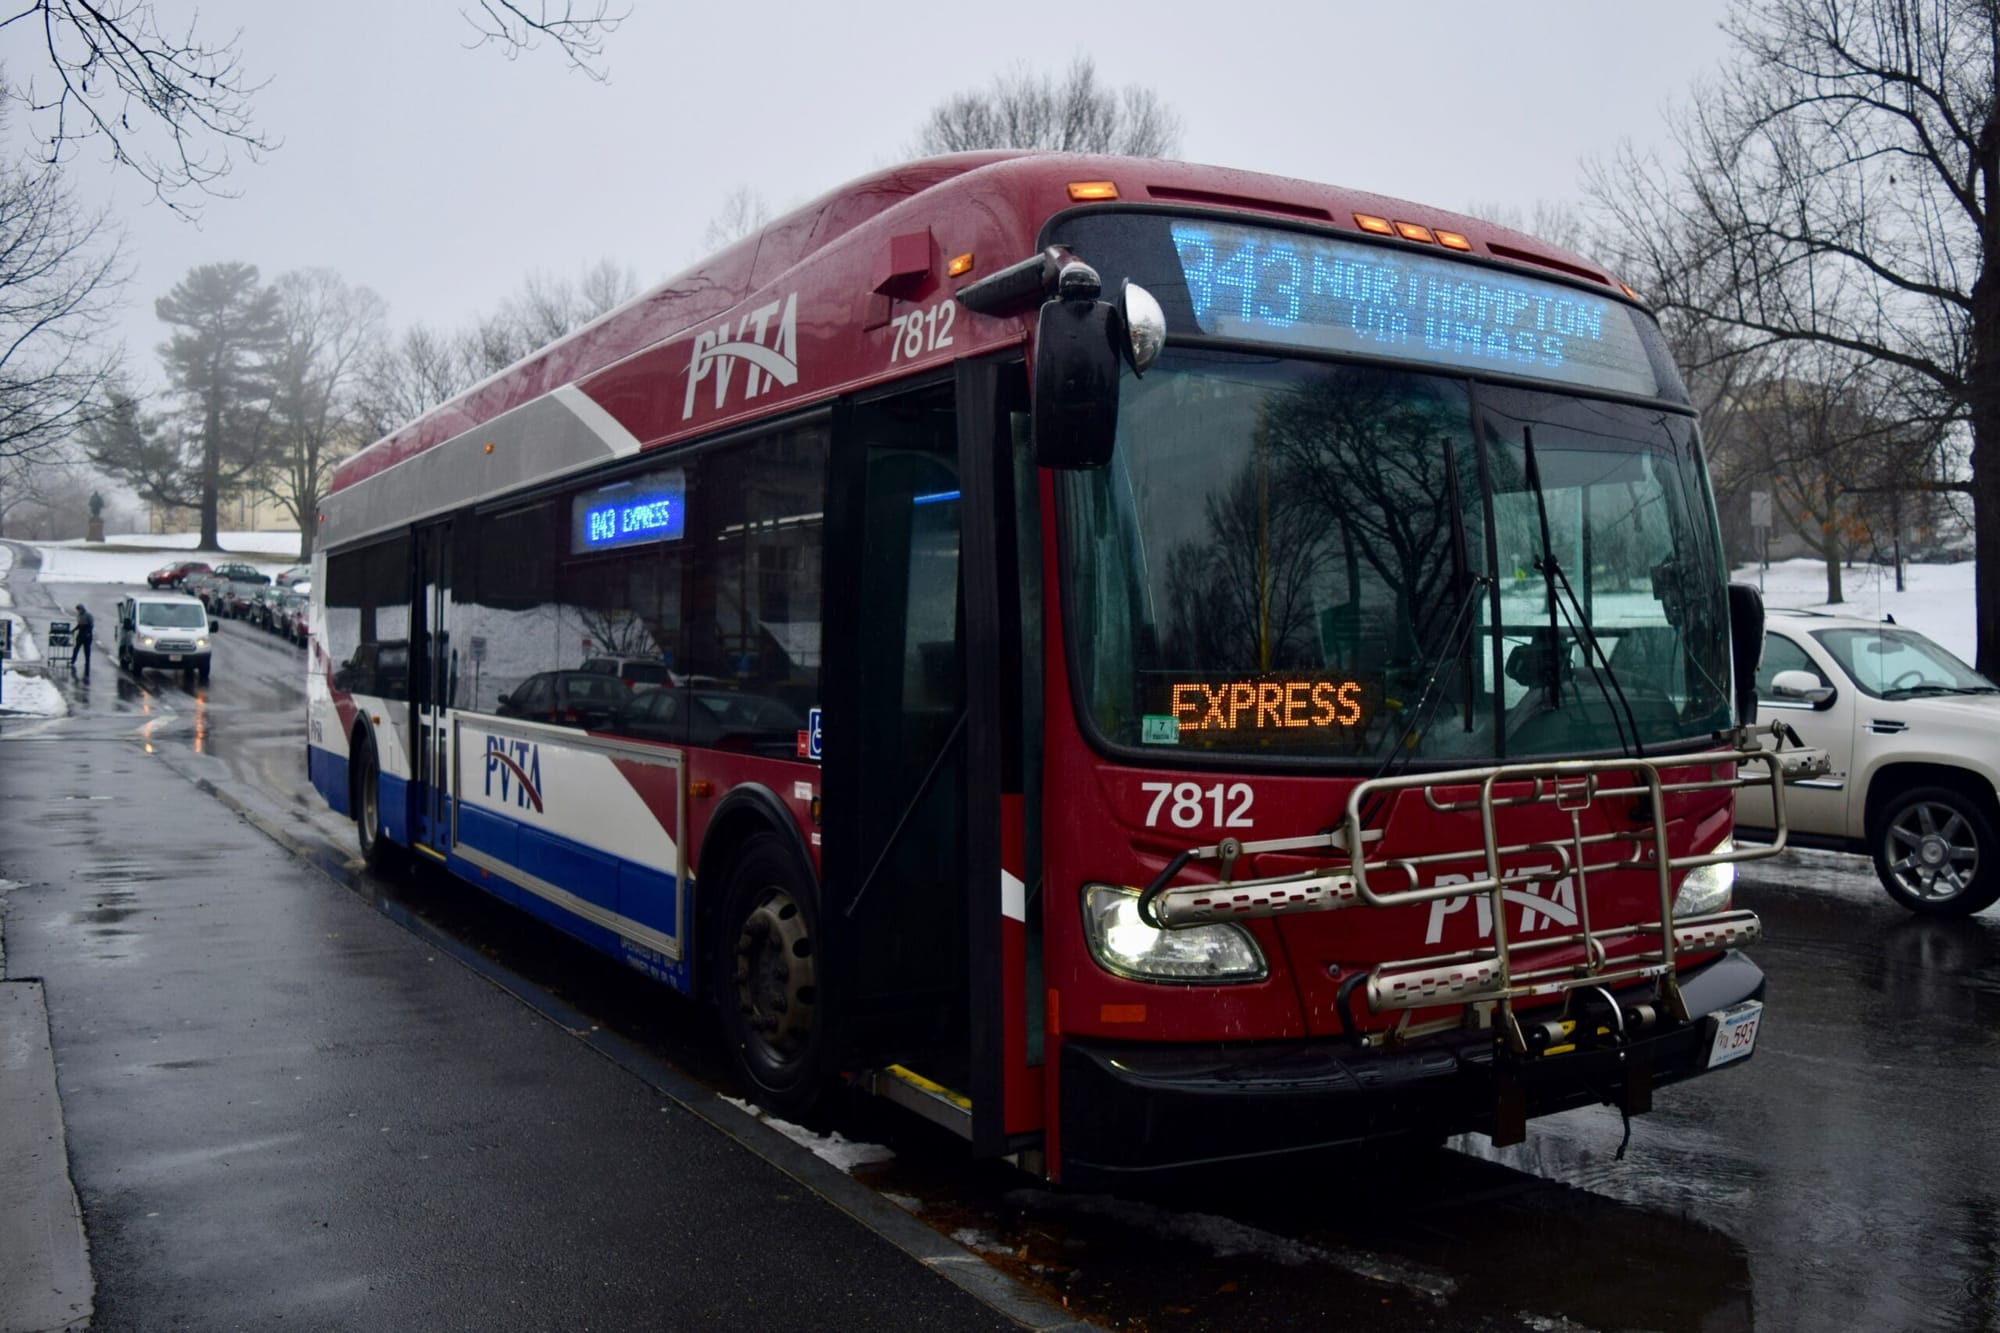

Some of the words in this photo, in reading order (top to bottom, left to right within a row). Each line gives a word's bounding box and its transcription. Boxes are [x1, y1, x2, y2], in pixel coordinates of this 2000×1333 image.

[681, 292, 798, 420] PVTA
[891, 299, 956, 363] 7812
[1351, 304, 1407, 344] VIA
[1425, 316, 1564, 367] UMASS
[1172, 682, 1362, 730] EXPRESS
[482, 735, 544, 815] PVTA
[1141, 782, 1254, 828] 7812
[1425, 864, 1579, 945] PVTA
[1732, 1020, 1756, 1049] 593
